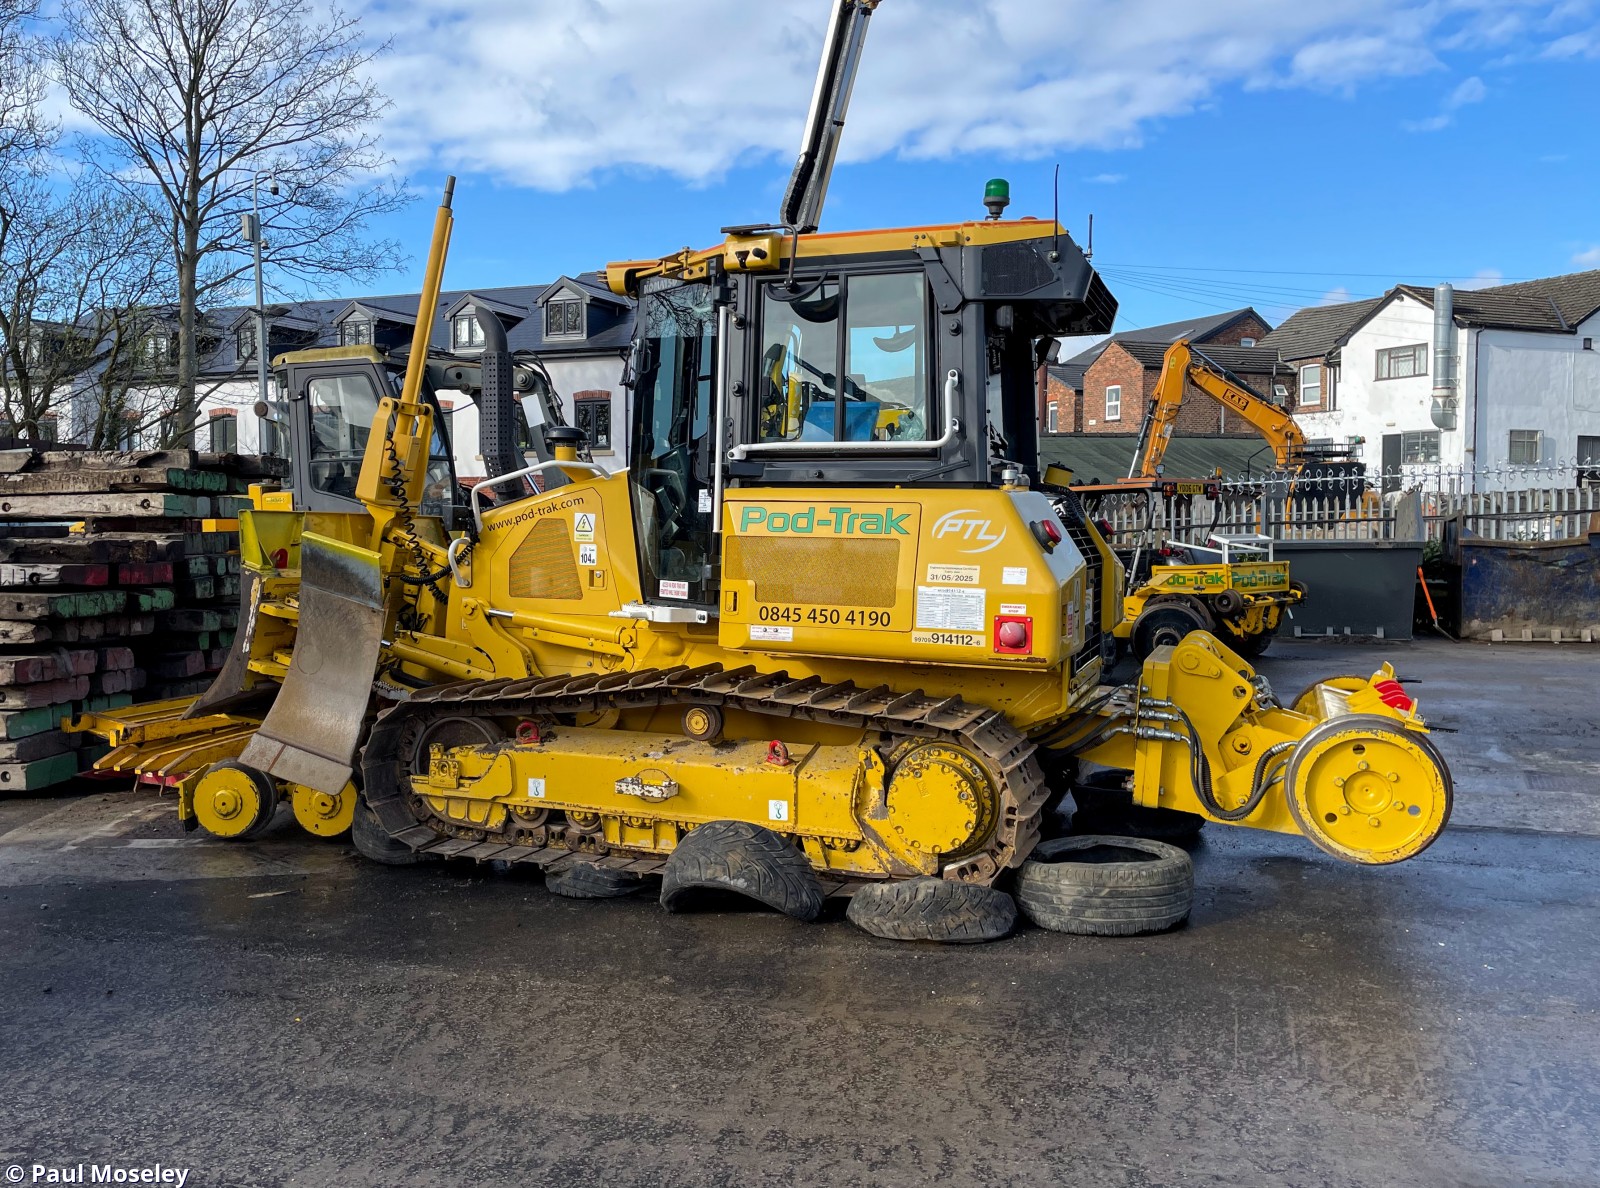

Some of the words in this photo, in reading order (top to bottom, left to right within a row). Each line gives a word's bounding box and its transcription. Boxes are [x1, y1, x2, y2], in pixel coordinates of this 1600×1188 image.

[487, 497, 585, 532] www.pod-trak.com
[740, 506, 912, 535] Pod-Trak
[936, 519, 998, 540] PTL
[581, 553, 592, 564] 104
[930, 574, 974, 582] 31/05/2025
[759, 605, 802, 623] 0845
[806, 608, 841, 625] 450
[844, 610, 891, 627] 4190
